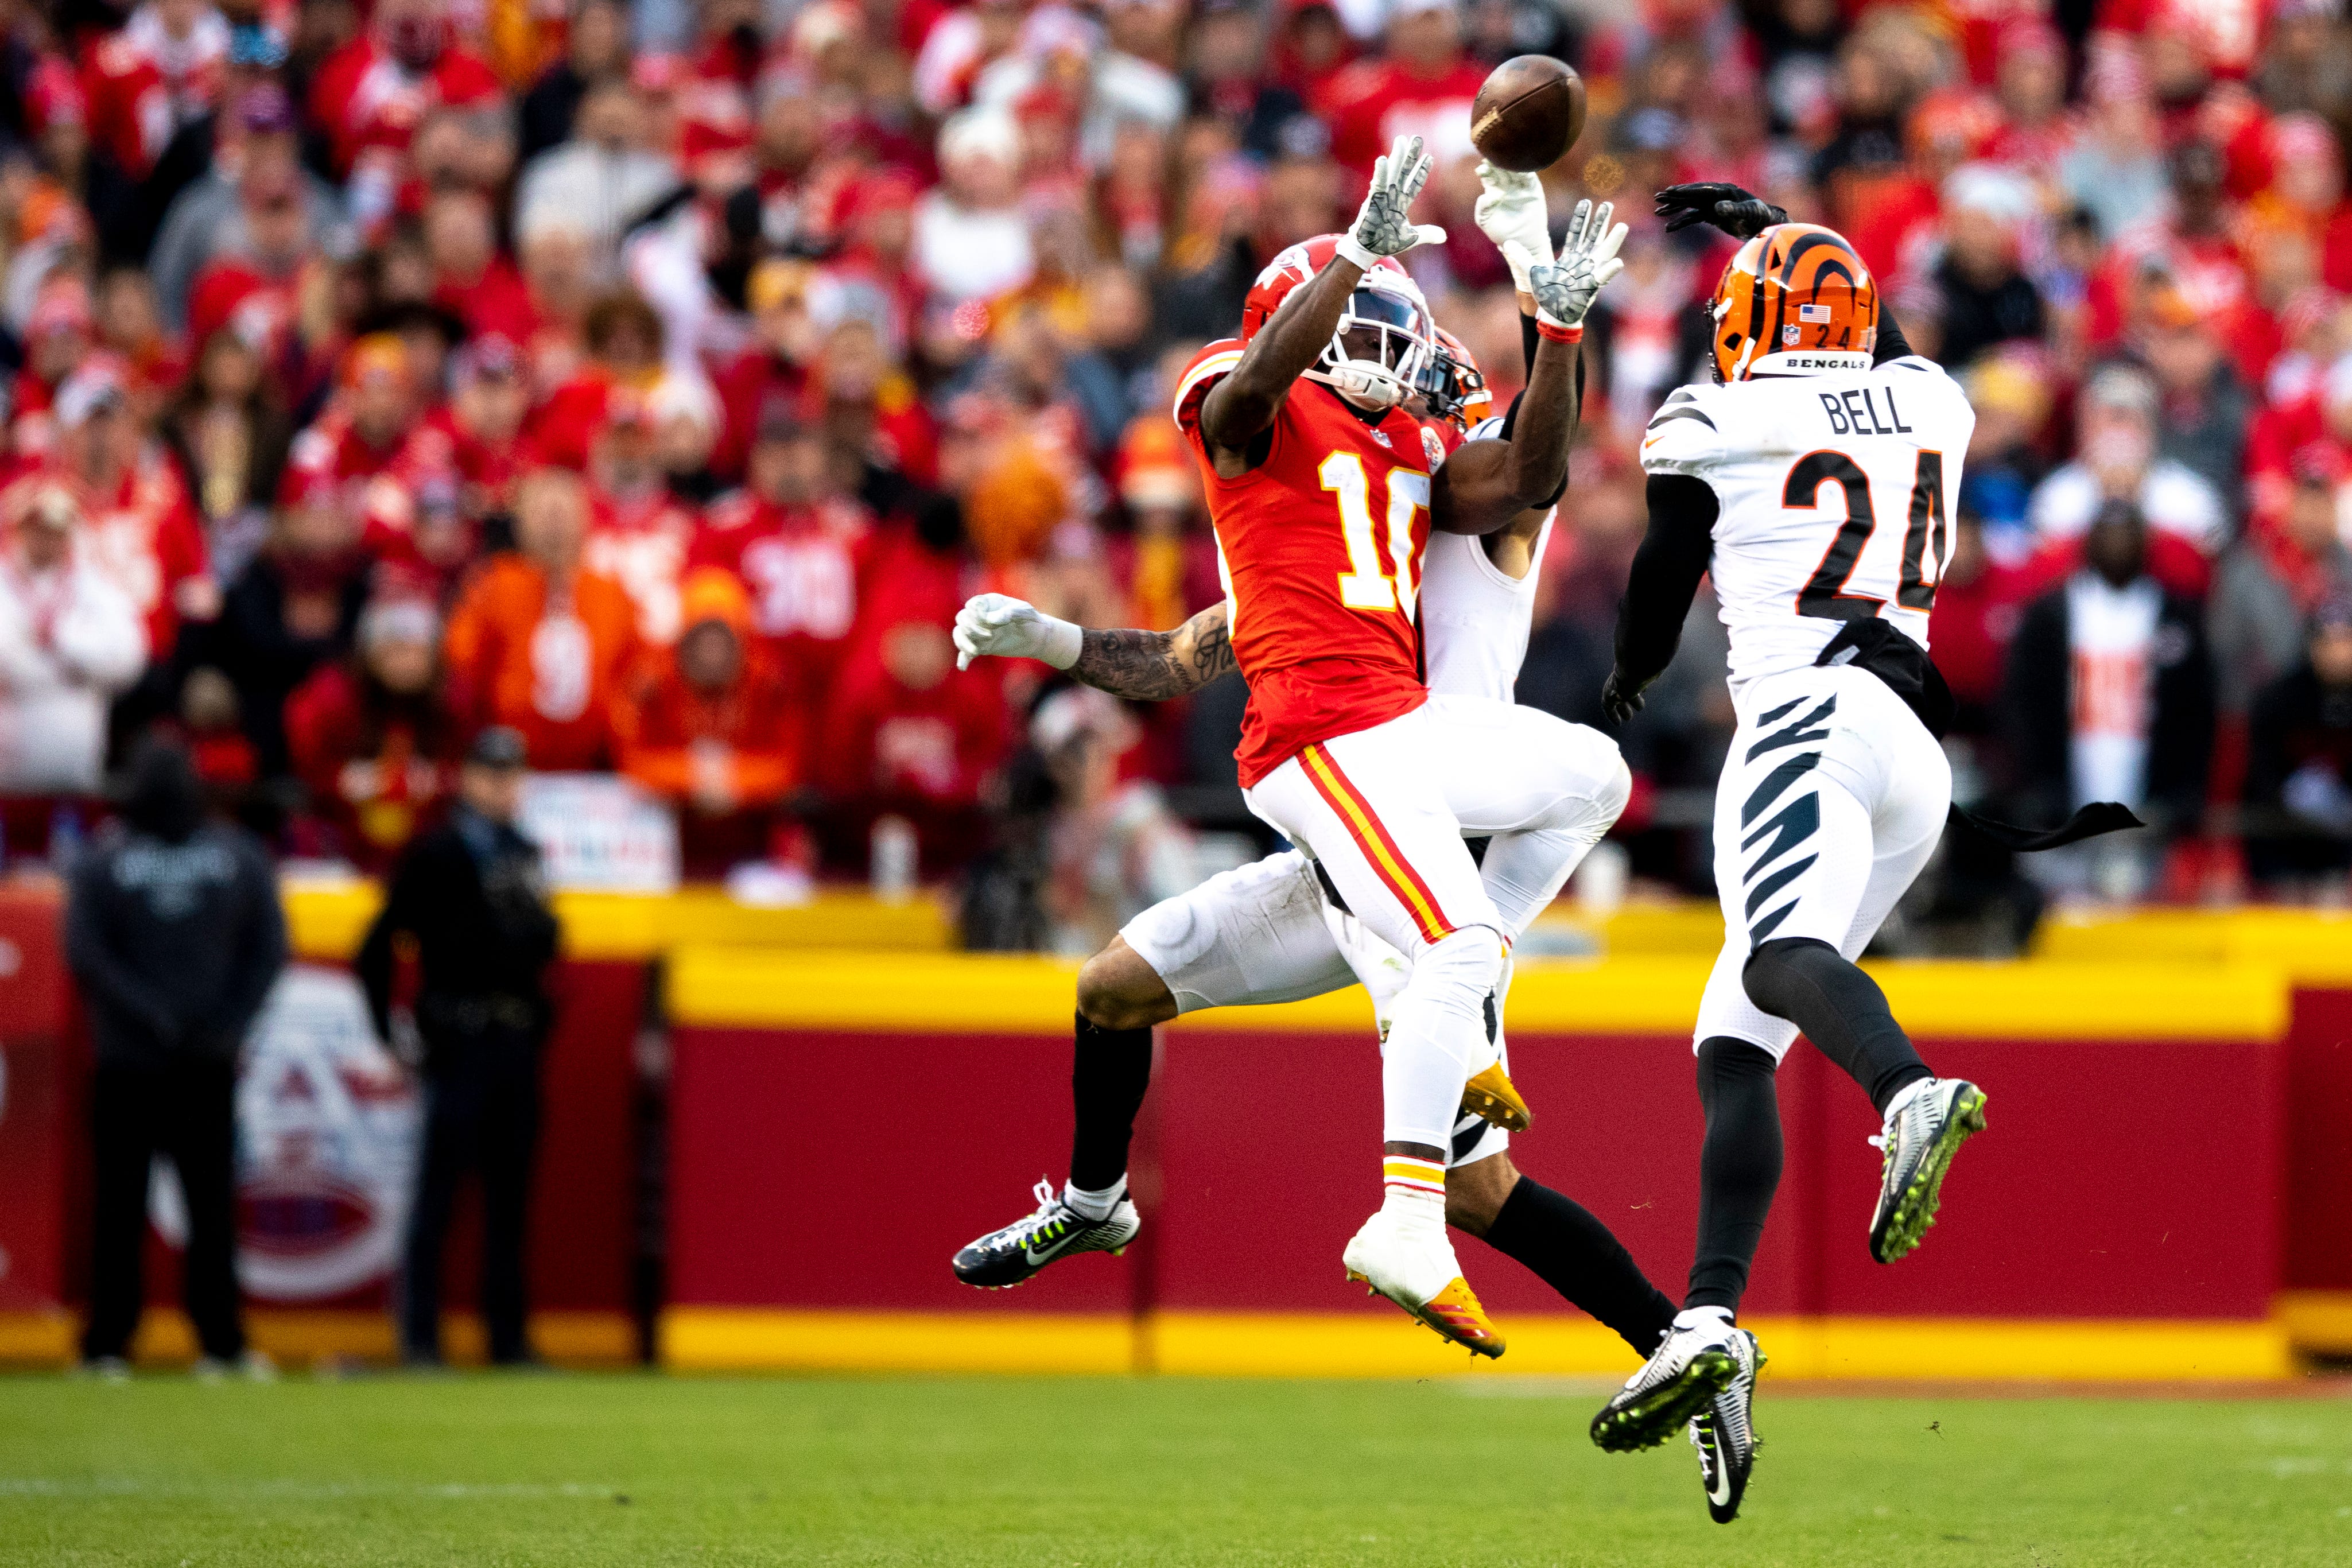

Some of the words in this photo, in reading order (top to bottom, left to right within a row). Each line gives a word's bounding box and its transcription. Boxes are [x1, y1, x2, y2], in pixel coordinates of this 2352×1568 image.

[1815, 324, 1850, 350] 24
[1786, 359, 1865, 369] BENGALS
[1818, 387, 1912, 434] BELL
[1782, 449, 1946, 618] 24
